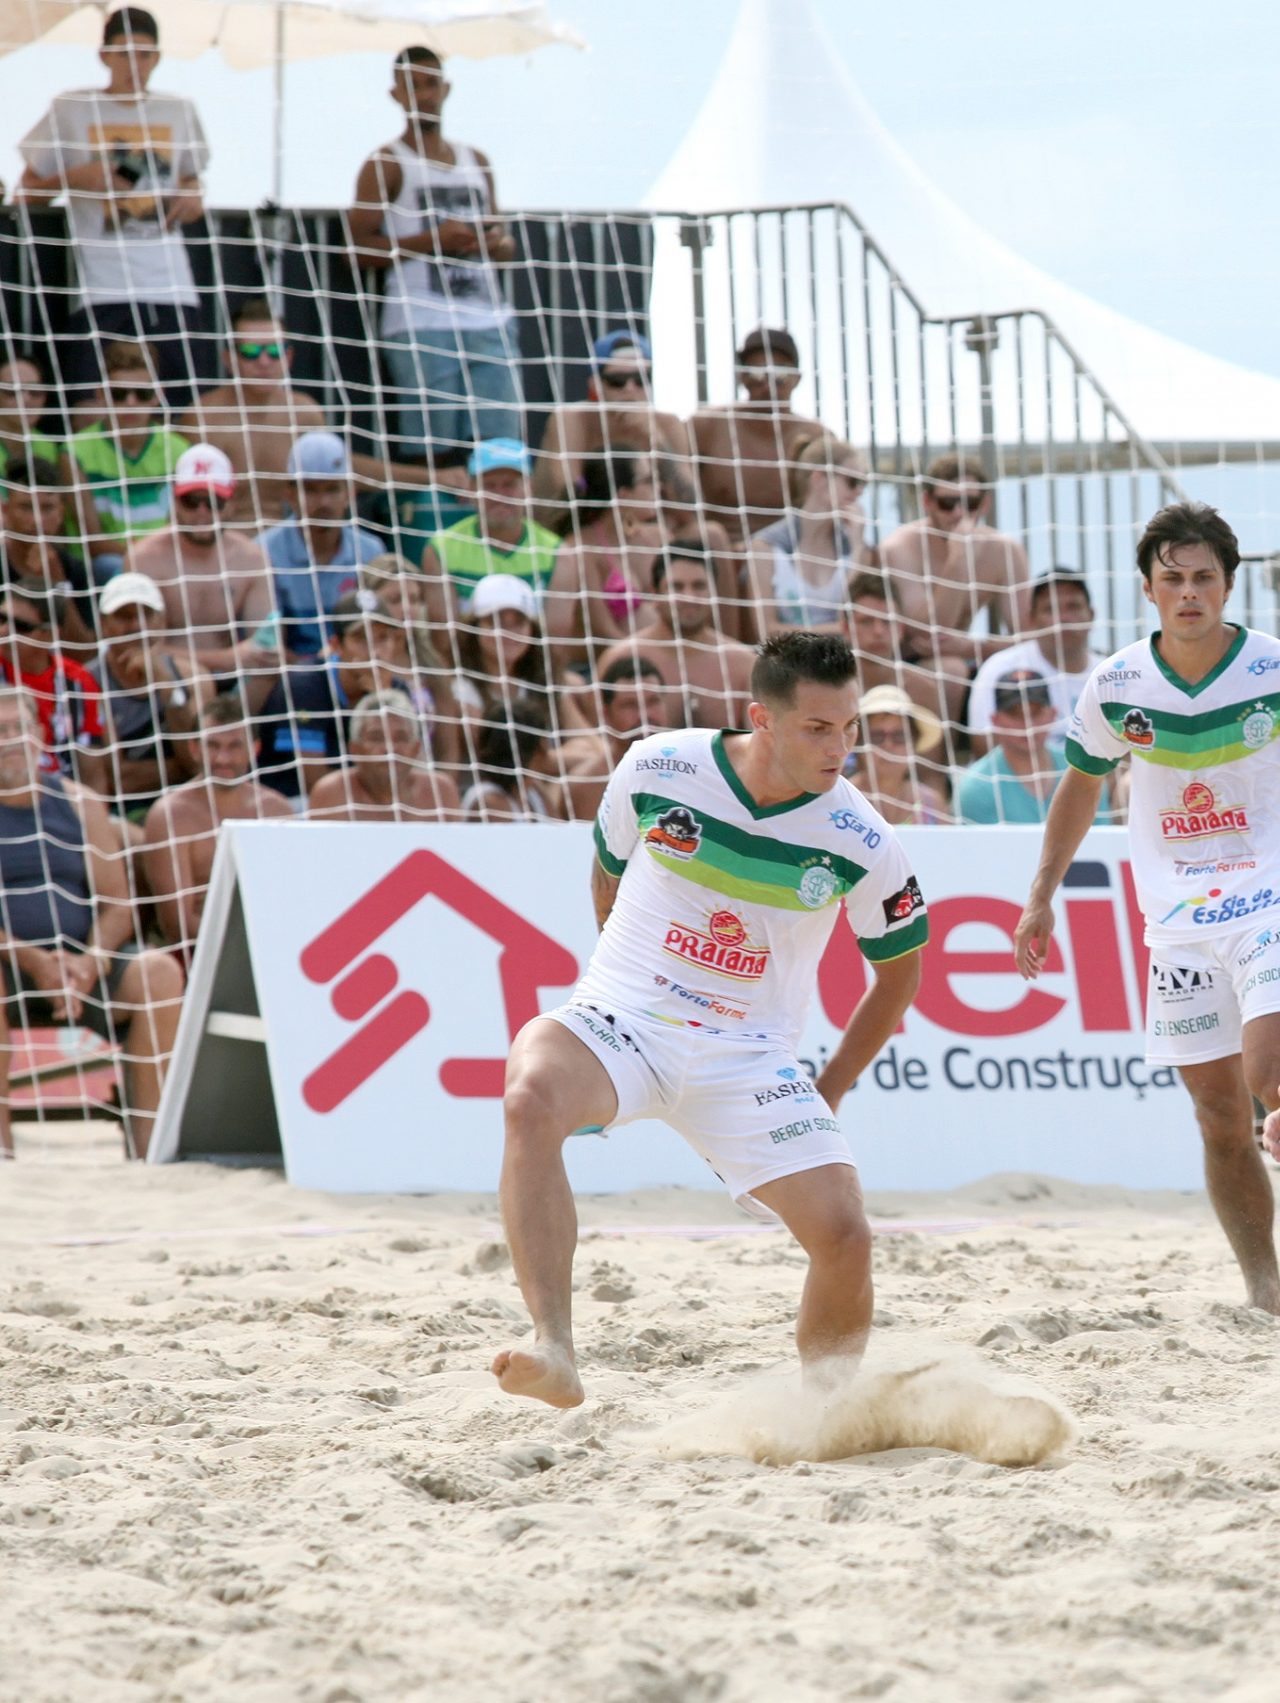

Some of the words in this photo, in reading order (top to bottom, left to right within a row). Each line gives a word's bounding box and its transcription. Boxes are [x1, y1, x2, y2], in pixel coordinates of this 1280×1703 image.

[1097, 669, 1142, 686] FASHION
[635, 757, 698, 775] FASHION
[861, 827, 882, 849] 10
[874, 1048, 929, 1091] de
[769, 1118, 814, 1145] BEACH
